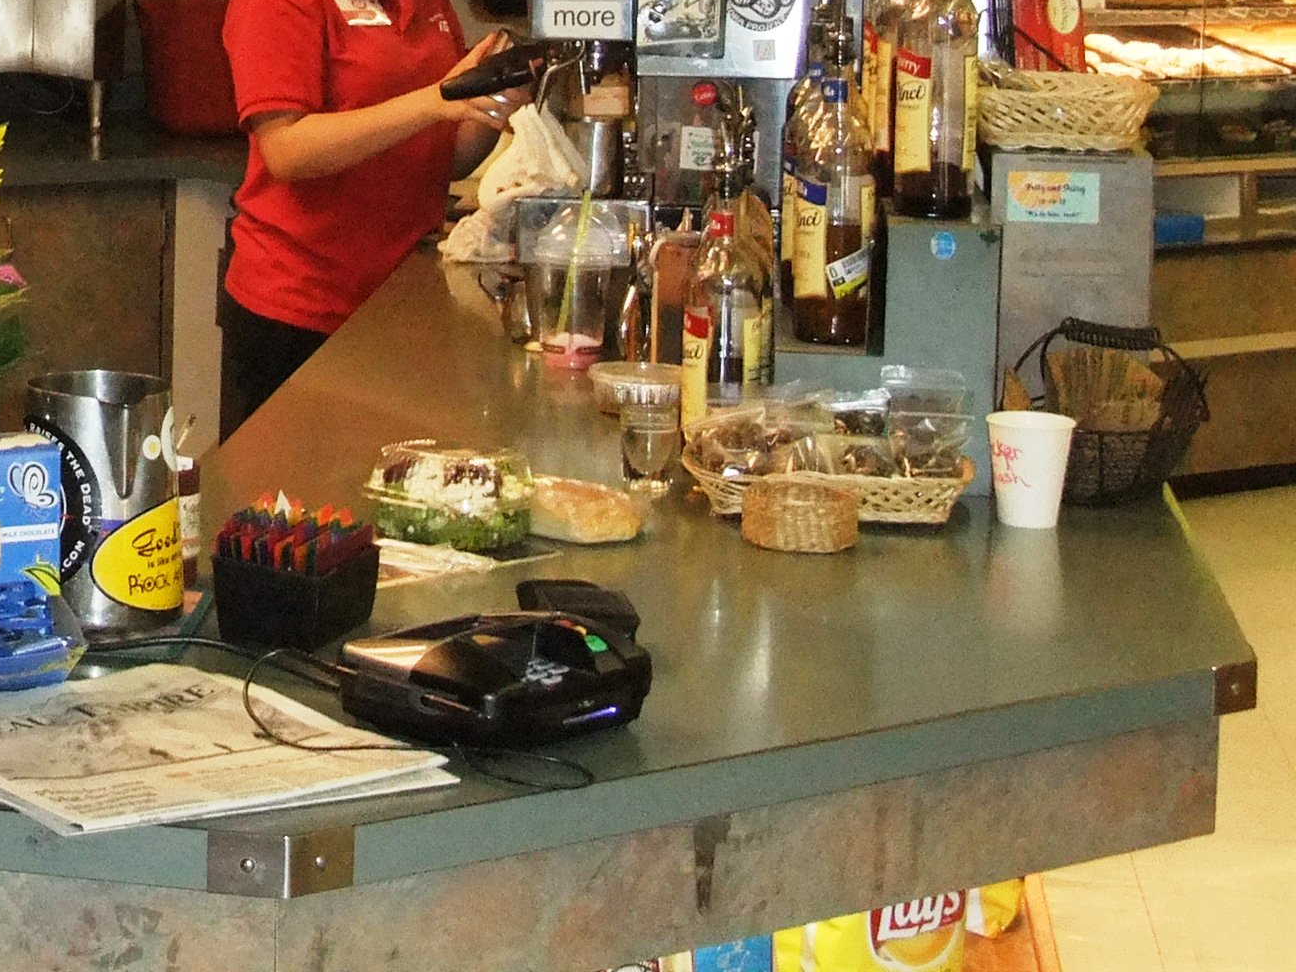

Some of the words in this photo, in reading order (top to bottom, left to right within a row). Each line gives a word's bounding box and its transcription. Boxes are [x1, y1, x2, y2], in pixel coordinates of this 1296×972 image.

[554, 8, 615, 27] more
[65, 451, 86, 480] THE
[80, 483, 92, 526] DEAD
[19, 529, 55, 537] CHOCOLATE
[876, 890, 961, 941] Lays
